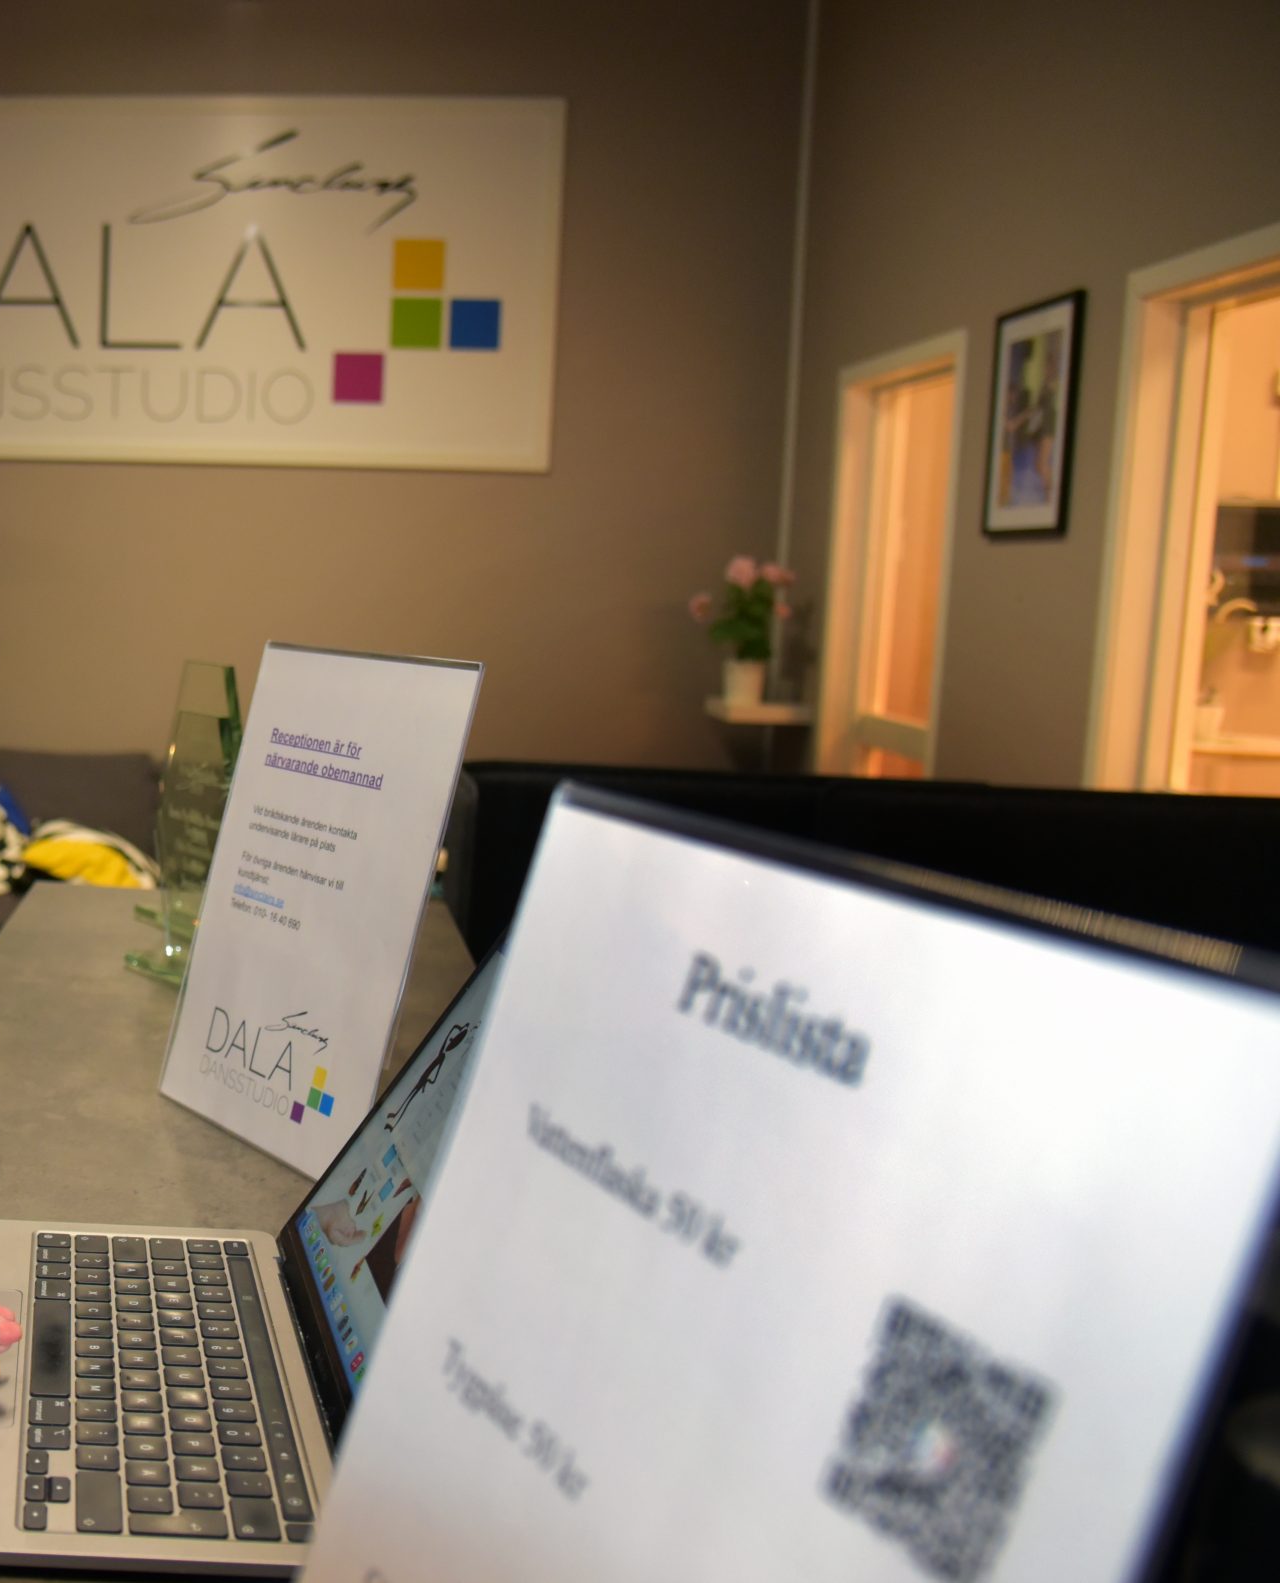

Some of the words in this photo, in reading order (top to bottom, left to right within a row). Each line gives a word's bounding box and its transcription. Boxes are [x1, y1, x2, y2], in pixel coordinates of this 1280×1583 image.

[270, 727, 332, 753] Receptionen
[332, 739, 345, 753] är
[345, 741, 363, 757] för
[264, 751, 320, 774] närvarande
[320, 763, 384, 787] obemannad
[248, 820, 290, 839] undervisande
[309, 837, 319, 849] på
[318, 839, 336, 853] plats
[252, 804, 263, 815] Vid
[300, 816, 328, 832] ärenden
[327, 824, 358, 840] kontakta
[271, 860, 299, 877] ärenden
[298, 868, 327, 885] hänvisar
[334, 879, 344, 890] till
[277, 914, 287, 926] 40
[677, 950, 871, 1087] Prislista
[206, 1006, 292, 1091] DALA
[200, 1052, 289, 1117] DANSSTUDIO
[662, 1190, 705, 1246] 50
[699, 1212, 743, 1270] kr
